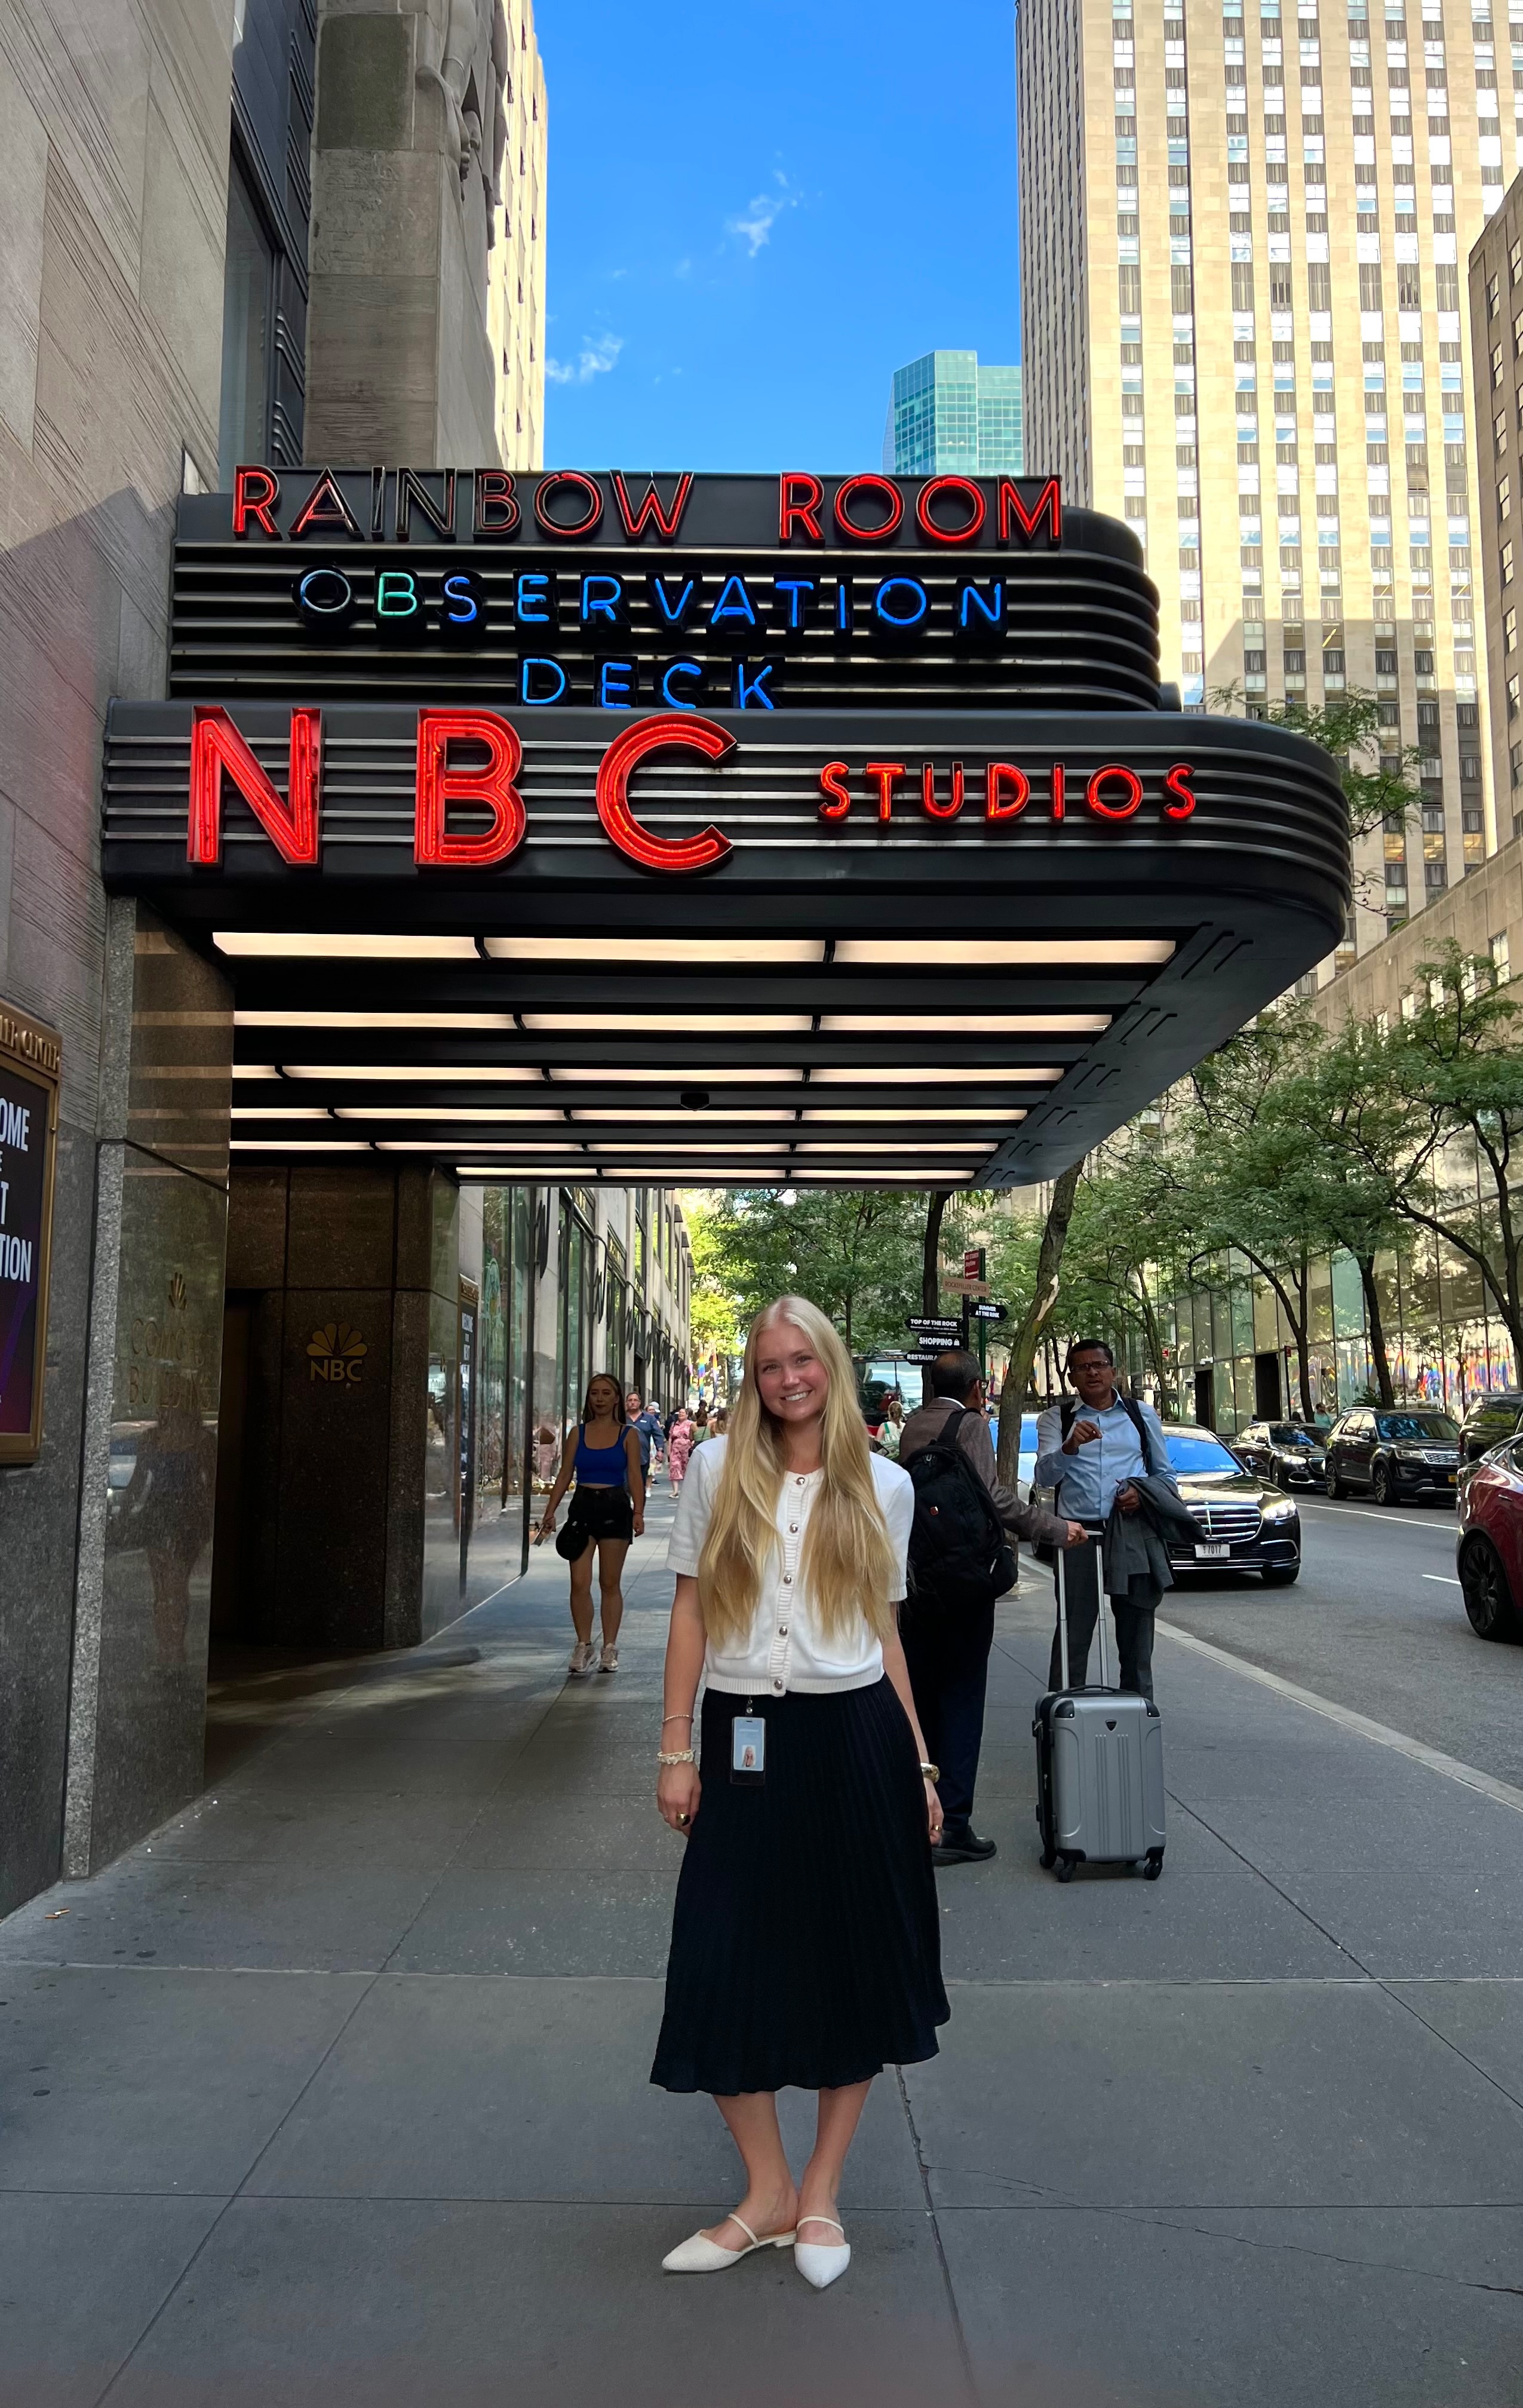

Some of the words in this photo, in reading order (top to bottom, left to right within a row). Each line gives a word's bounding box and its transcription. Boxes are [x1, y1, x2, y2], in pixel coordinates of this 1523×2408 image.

[232, 464, 695, 542] RAINBOW
[778, 472, 1062, 548] ROOM
[294, 566, 1006, 634] OBSERVATION
[520, 655, 779, 710] DECK
[186, 705, 736, 876] NBC
[818, 761, 1196, 824] STUDIOS
[20, 1030, 60, 1073] CENTER
[919, 1337, 953, 1346] SHOPPING
[309, 1359, 362, 1381] NBC
[1207, 1544, 1221, 1555] 7017
